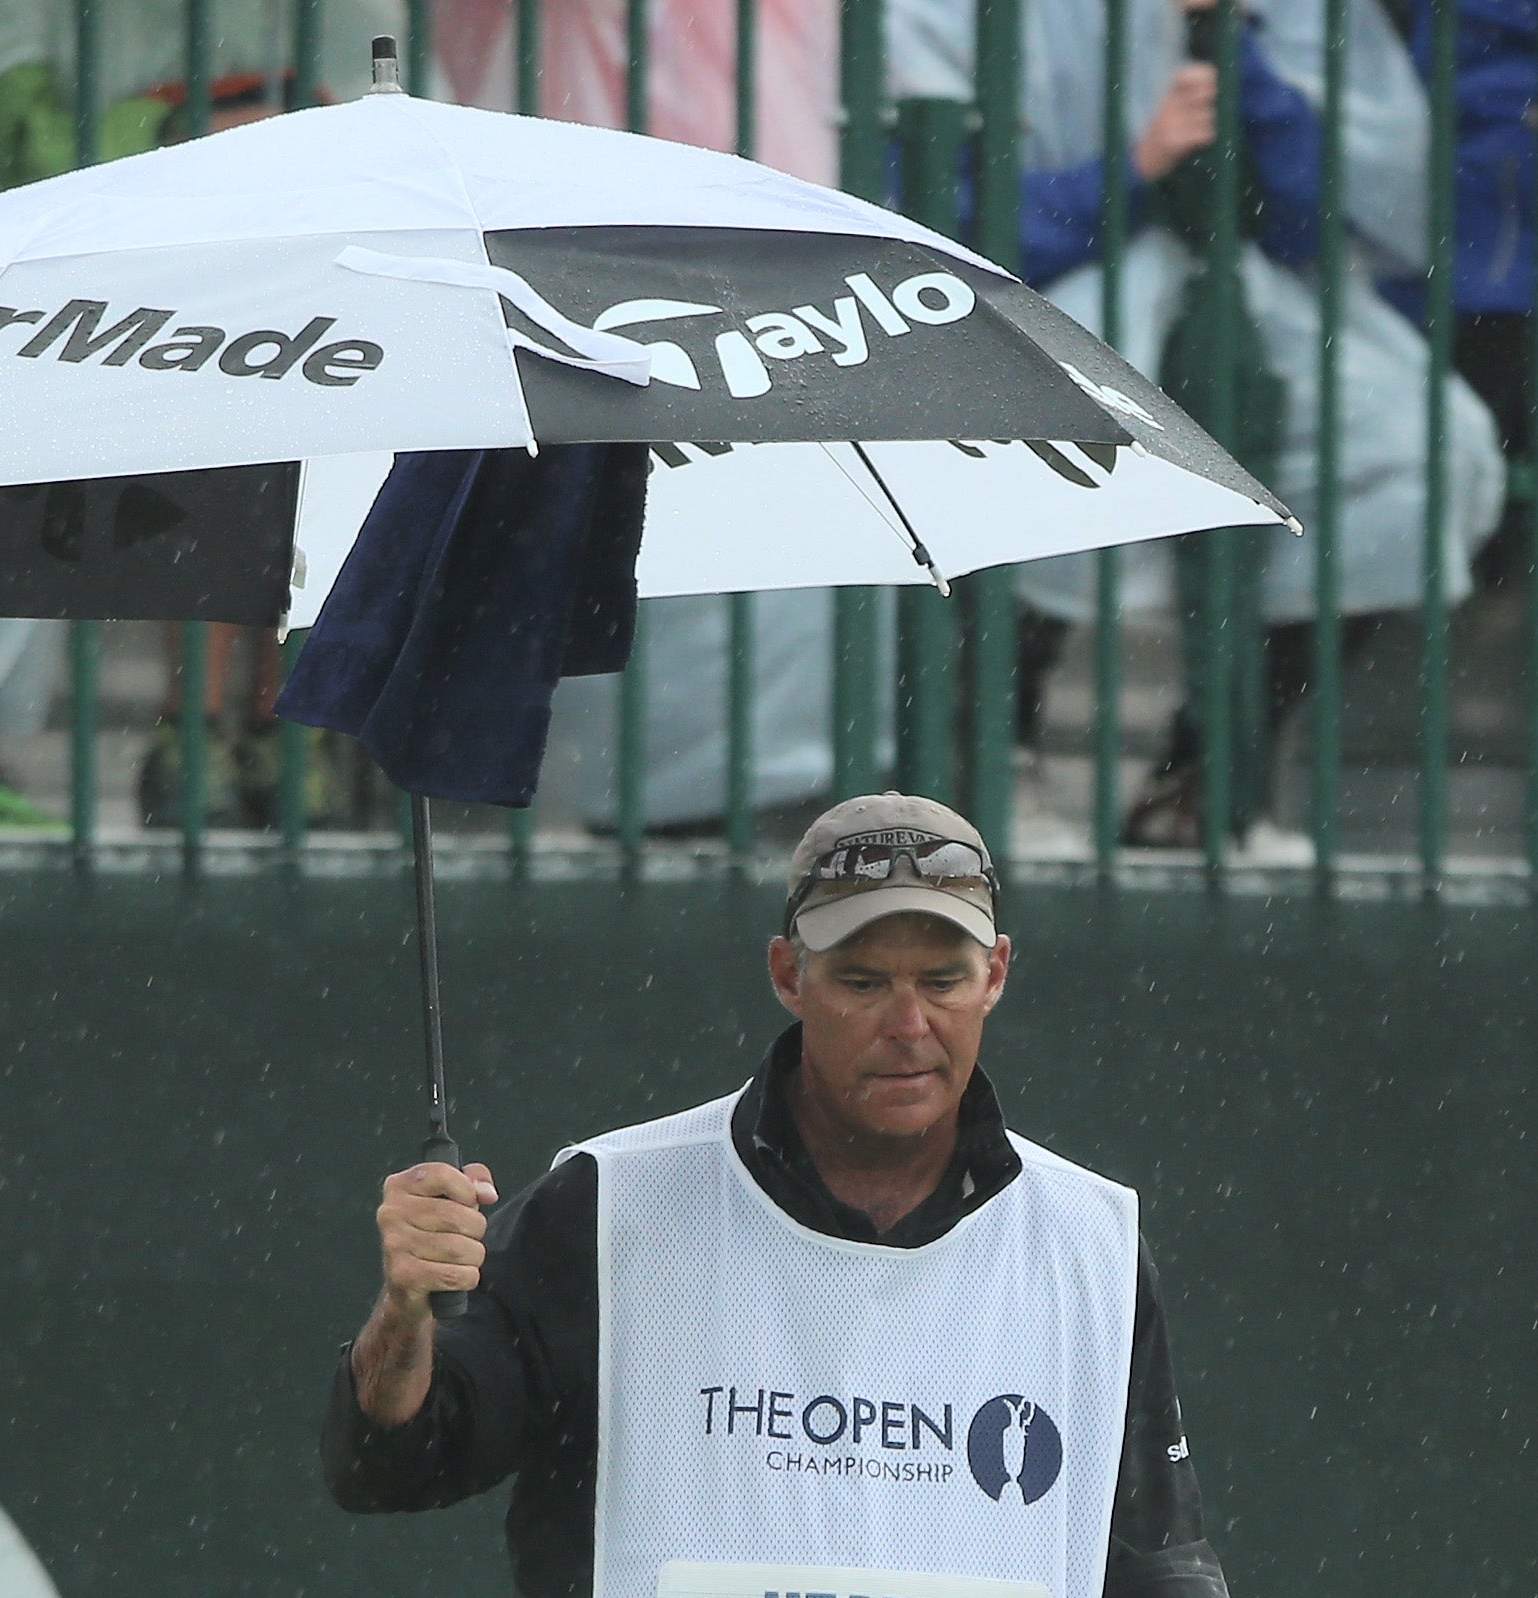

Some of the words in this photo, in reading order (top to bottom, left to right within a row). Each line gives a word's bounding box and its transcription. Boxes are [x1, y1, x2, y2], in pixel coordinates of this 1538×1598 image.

[700, 1386, 795, 1440] THE
[802, 1395, 954, 1451] OPEN
[766, 1451, 954, 1483] CHAMPIONSHIP
